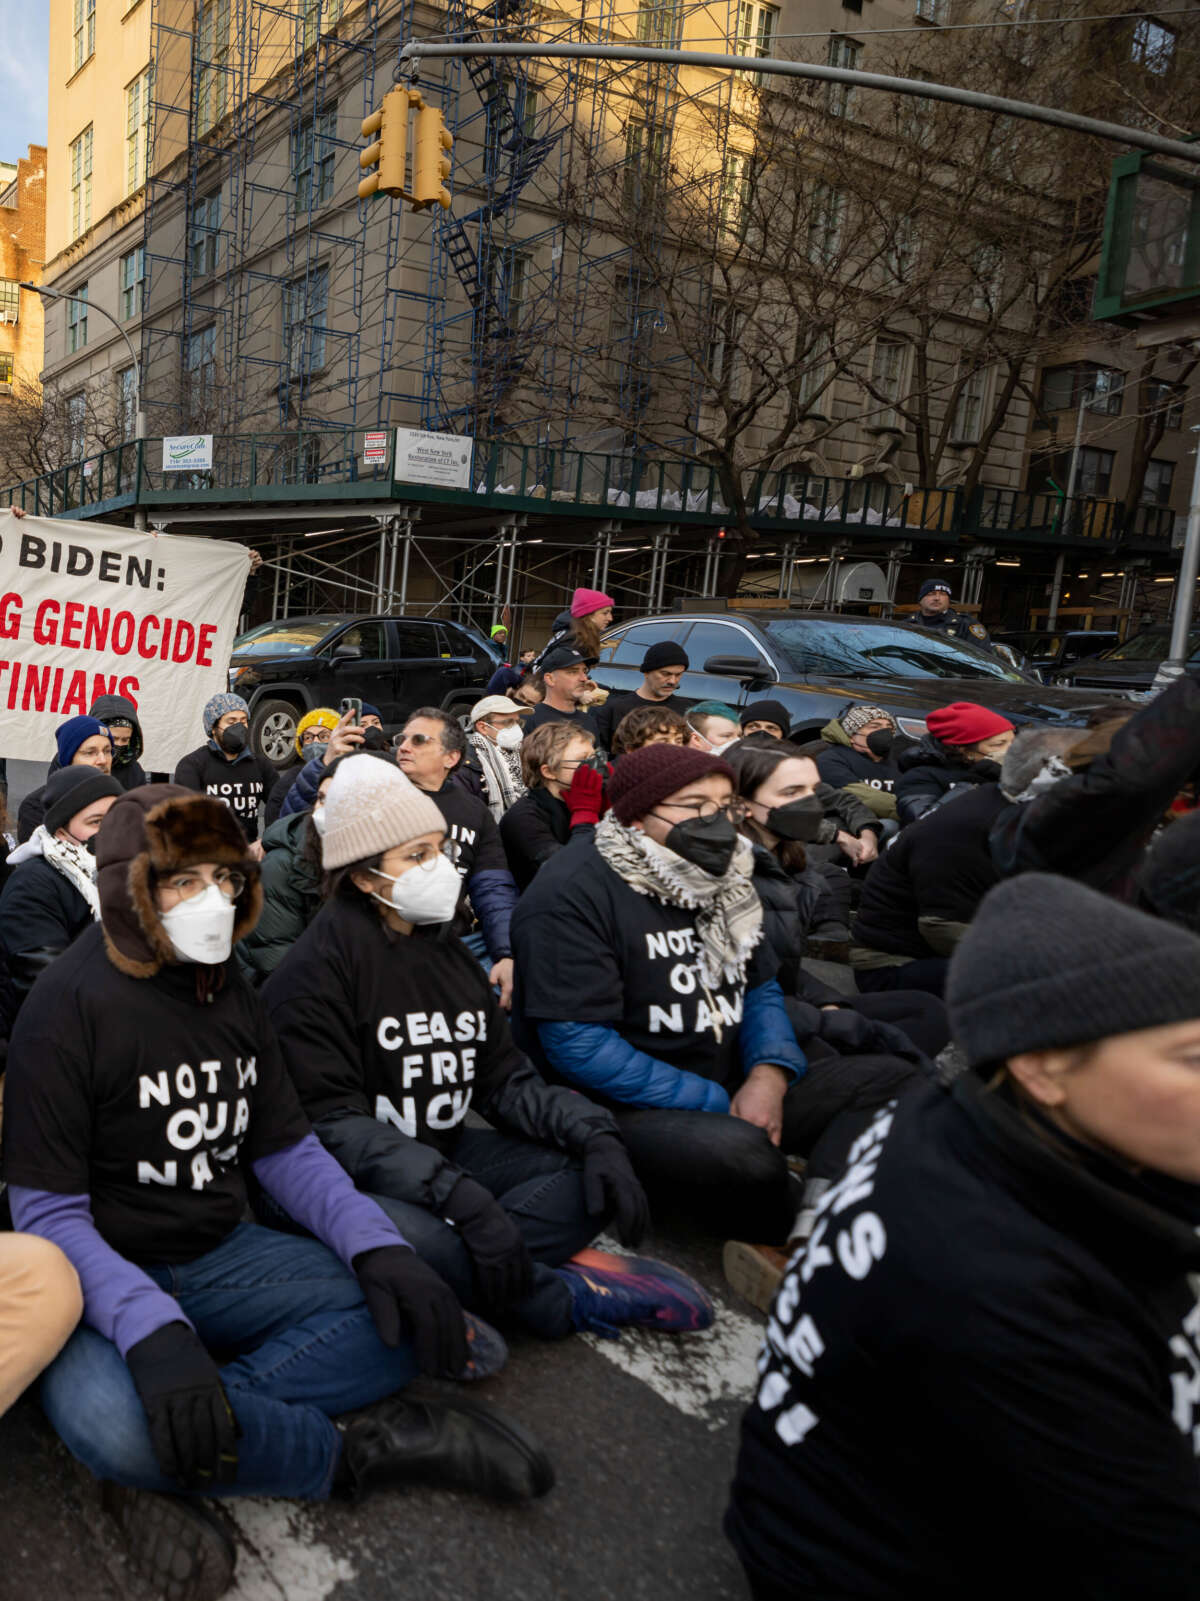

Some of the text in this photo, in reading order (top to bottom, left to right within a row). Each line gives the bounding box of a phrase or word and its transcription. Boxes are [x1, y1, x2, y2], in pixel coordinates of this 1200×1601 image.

[19, 533, 166, 591] BIDEN:
[33, 598, 217, 667] GENOCIDE
[206, 782, 264, 796] NOT IN
[864, 779, 894, 792] OT
[451, 823, 476, 846] IN
[645, 927, 696, 960] NOT
[138, 1060, 222, 1109] NOT
